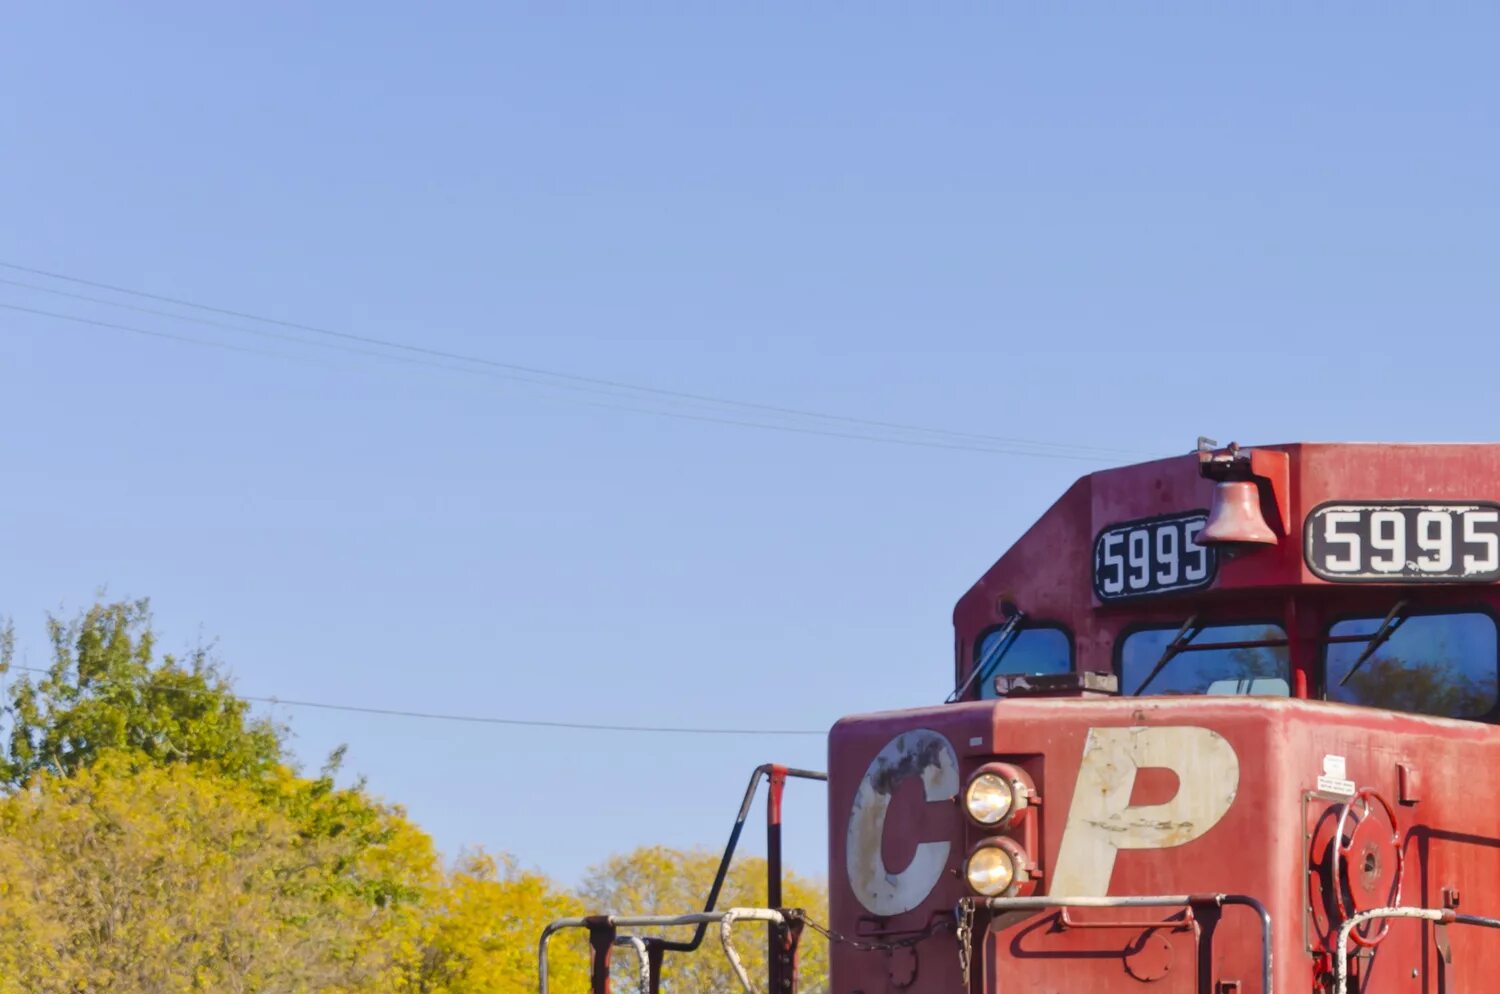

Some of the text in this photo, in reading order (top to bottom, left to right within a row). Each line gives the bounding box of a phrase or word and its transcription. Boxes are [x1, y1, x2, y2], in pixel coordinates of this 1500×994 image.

[1104, 519, 1207, 593] 5995
[1325, 511, 1499, 573] 5995
[847, 726, 1239, 917] CP
